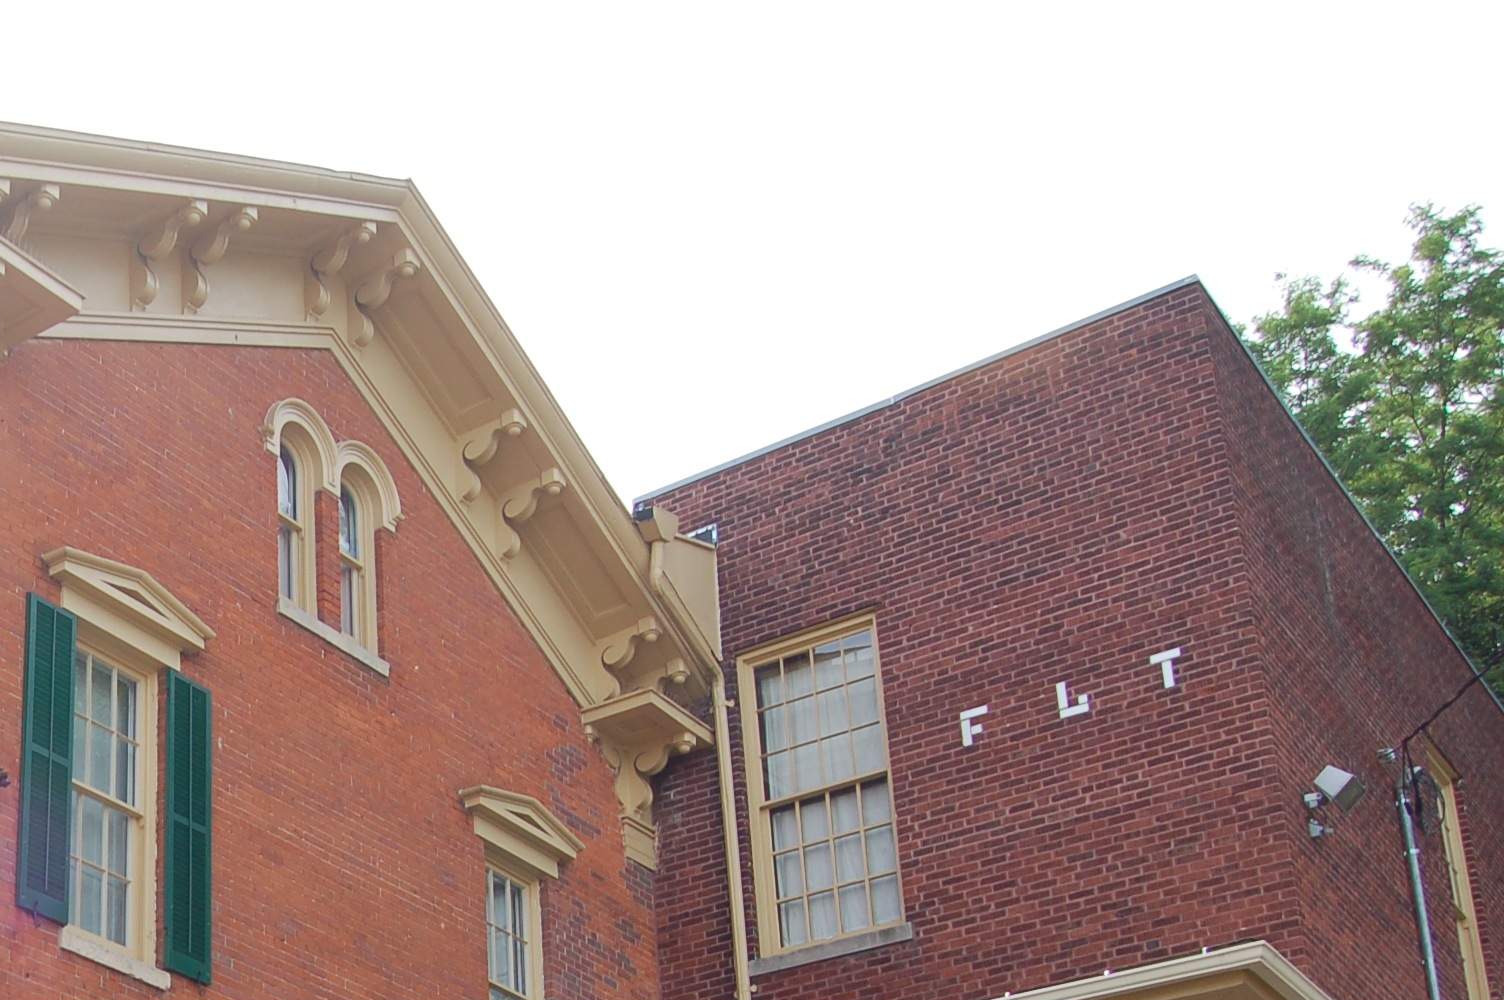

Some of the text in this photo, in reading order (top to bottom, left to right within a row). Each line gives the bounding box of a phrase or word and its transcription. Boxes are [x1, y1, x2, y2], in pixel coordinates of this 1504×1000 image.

[960, 647, 1181, 747] F L T
